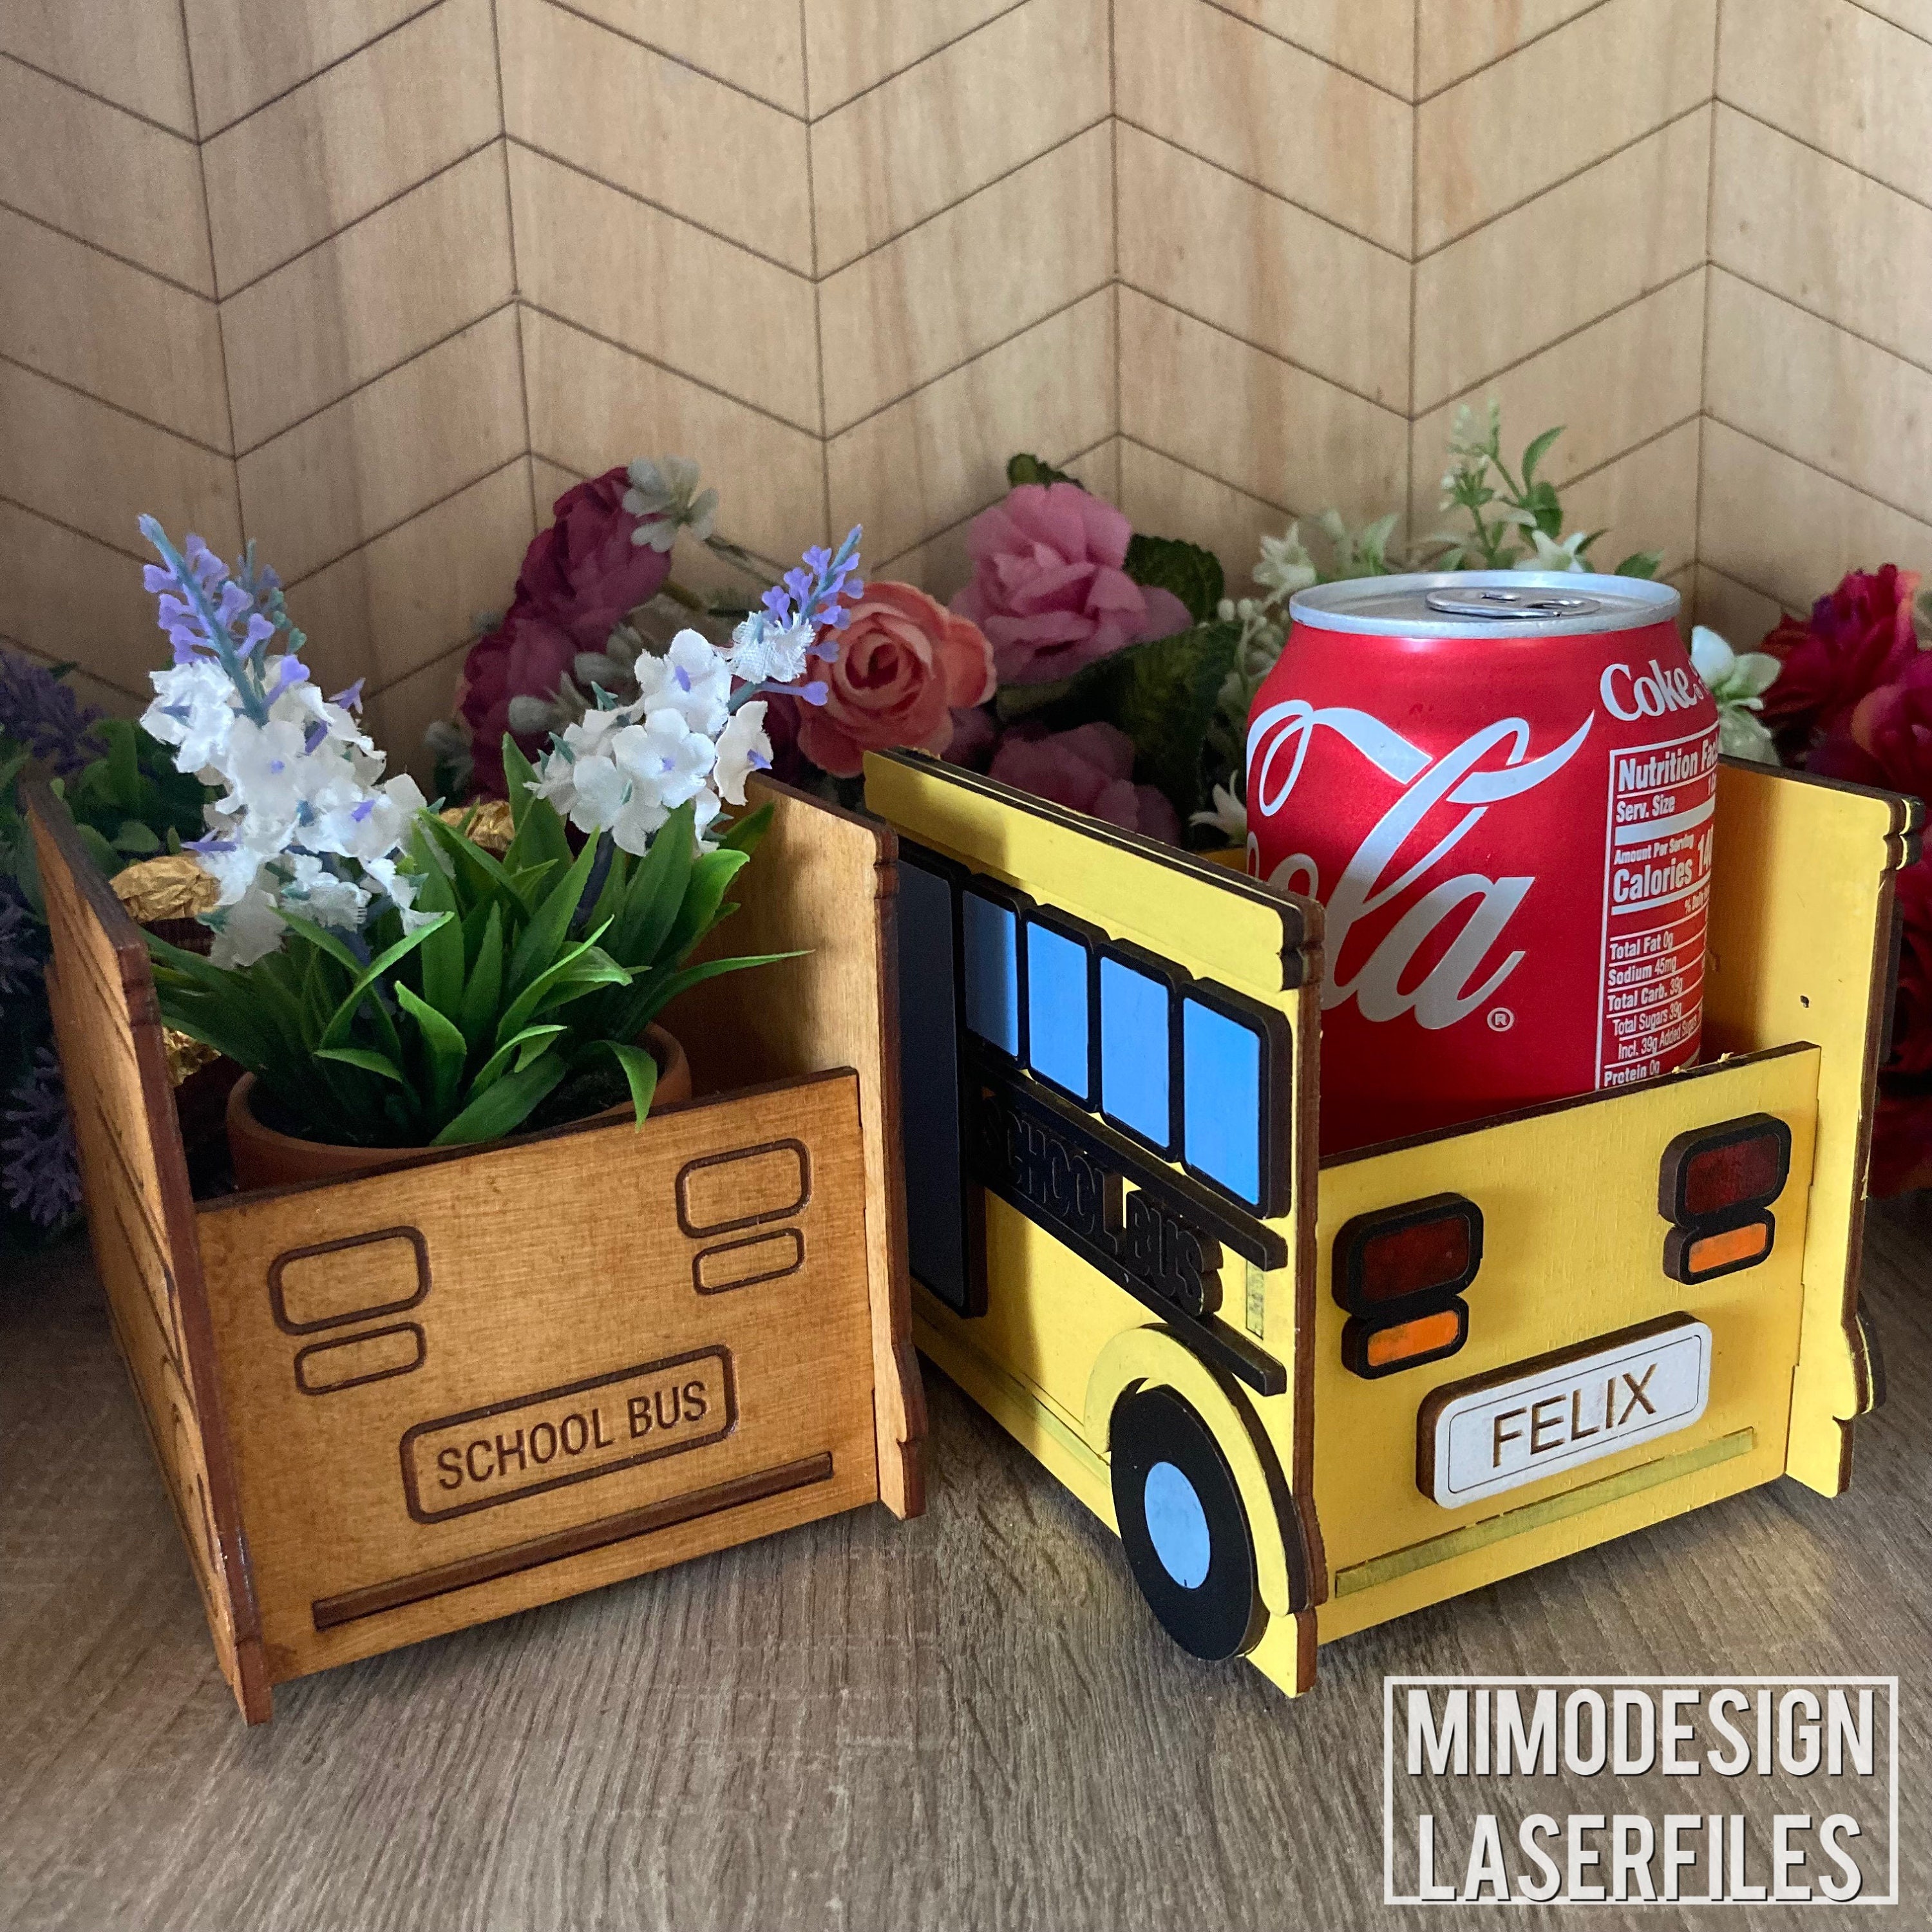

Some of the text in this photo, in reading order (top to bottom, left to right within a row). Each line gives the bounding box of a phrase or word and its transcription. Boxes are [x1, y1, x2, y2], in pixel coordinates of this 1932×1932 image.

[1600, 659, 1697, 721] Coke
[1618, 748, 1698, 791] Nutrition
[1616, 794, 1675, 822] Serv. Size
[1614, 834, 1694, 865] Amount Per Serving
[1613, 858, 1692, 902] Calories
[1610, 931, 1674, 960] Total Fat 0g
[1608, 956, 1677, 986] Sodium 45mg
[1607, 977, 1683, 1011] Total Carb. 39g
[1613, 1015, 1636, 1036] Total
[1639, 1009, 1668, 1030] Sugars
[1669, 1001, 1682, 1019] 39g
[1618, 1040, 1638, 1059] Incl.
[1641, 1036, 1658, 1054] 39g
[1659, 1023, 1681, 1048] Added
[1604, 1064, 1647, 1087] Protein
[1126, 1191, 1217, 1316] BUS
[1493, 1363, 1658, 1468] FELIX
[438, 1380, 707, 1490] SCHOOL BUS
